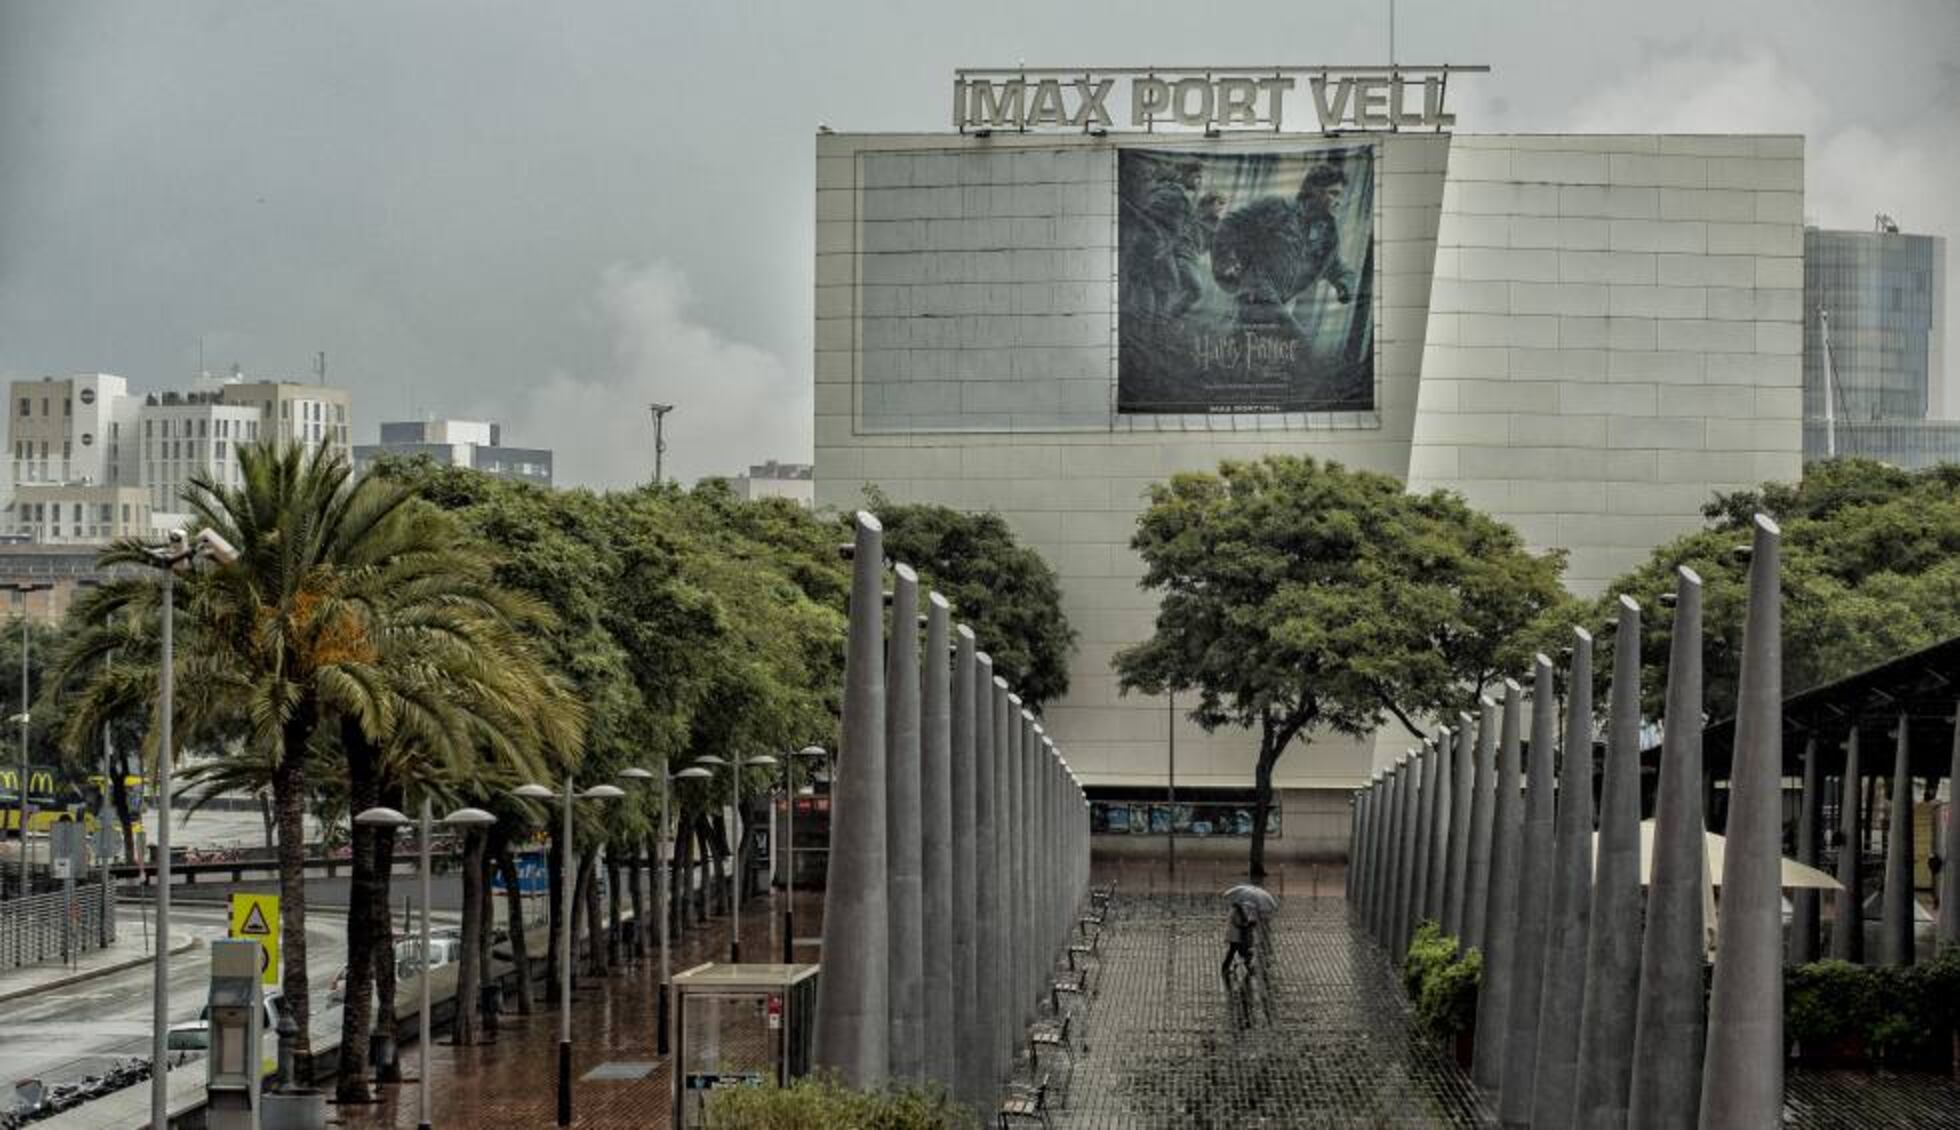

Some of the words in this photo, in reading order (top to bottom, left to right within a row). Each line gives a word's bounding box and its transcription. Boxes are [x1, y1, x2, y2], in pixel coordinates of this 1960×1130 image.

[954, 79, 1115, 127] IMAX
[1132, 77, 1295, 126] PORT
[1309, 76, 1457, 126] VELL
